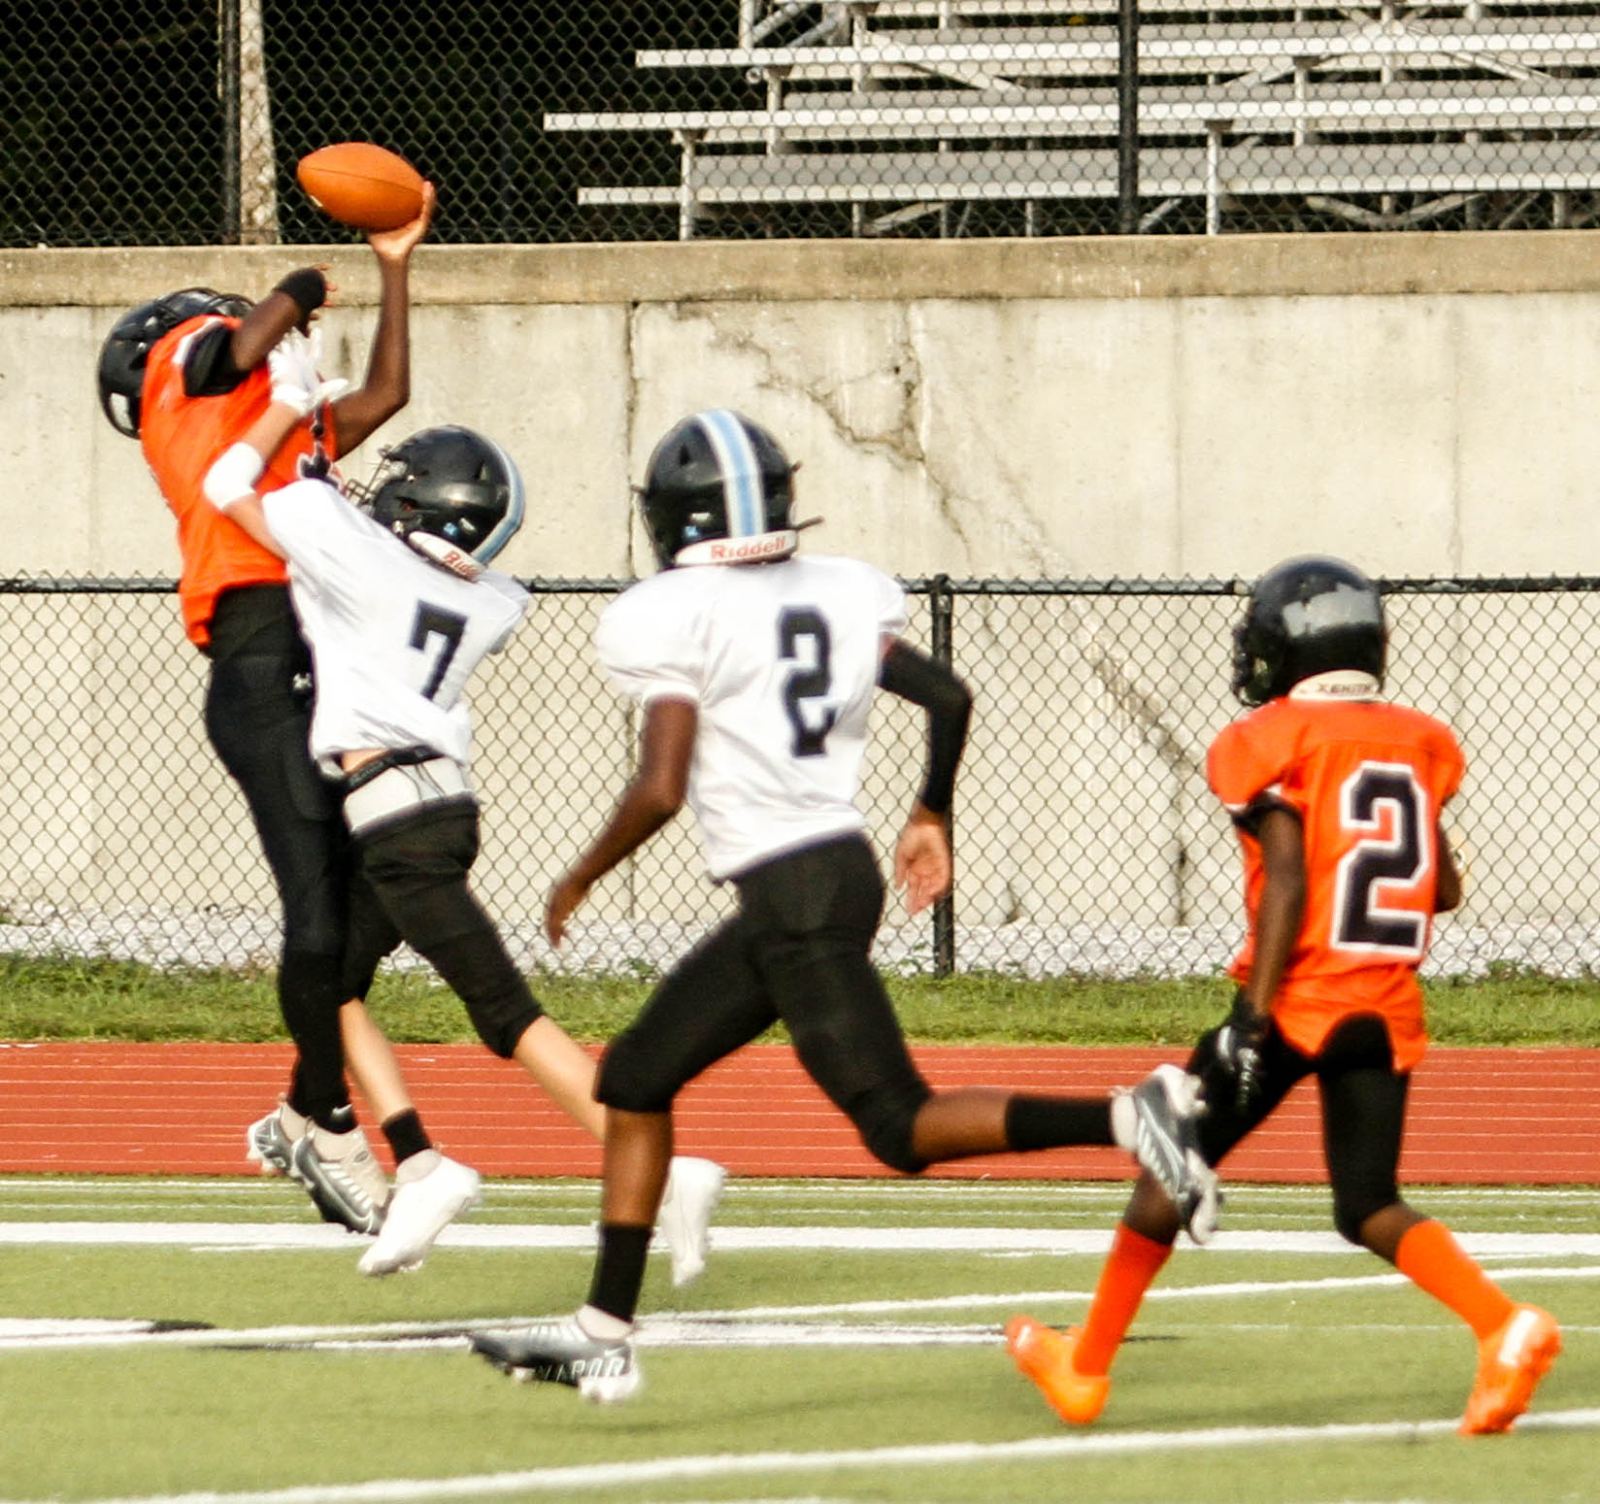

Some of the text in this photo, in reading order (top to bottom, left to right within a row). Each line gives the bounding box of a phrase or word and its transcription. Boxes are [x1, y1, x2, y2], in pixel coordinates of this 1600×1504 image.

[711, 536, 786, 559] Riddell
[407, 598, 468, 701] 7
[774, 603, 836, 760] 2
[1331, 760, 1429, 958] 2
